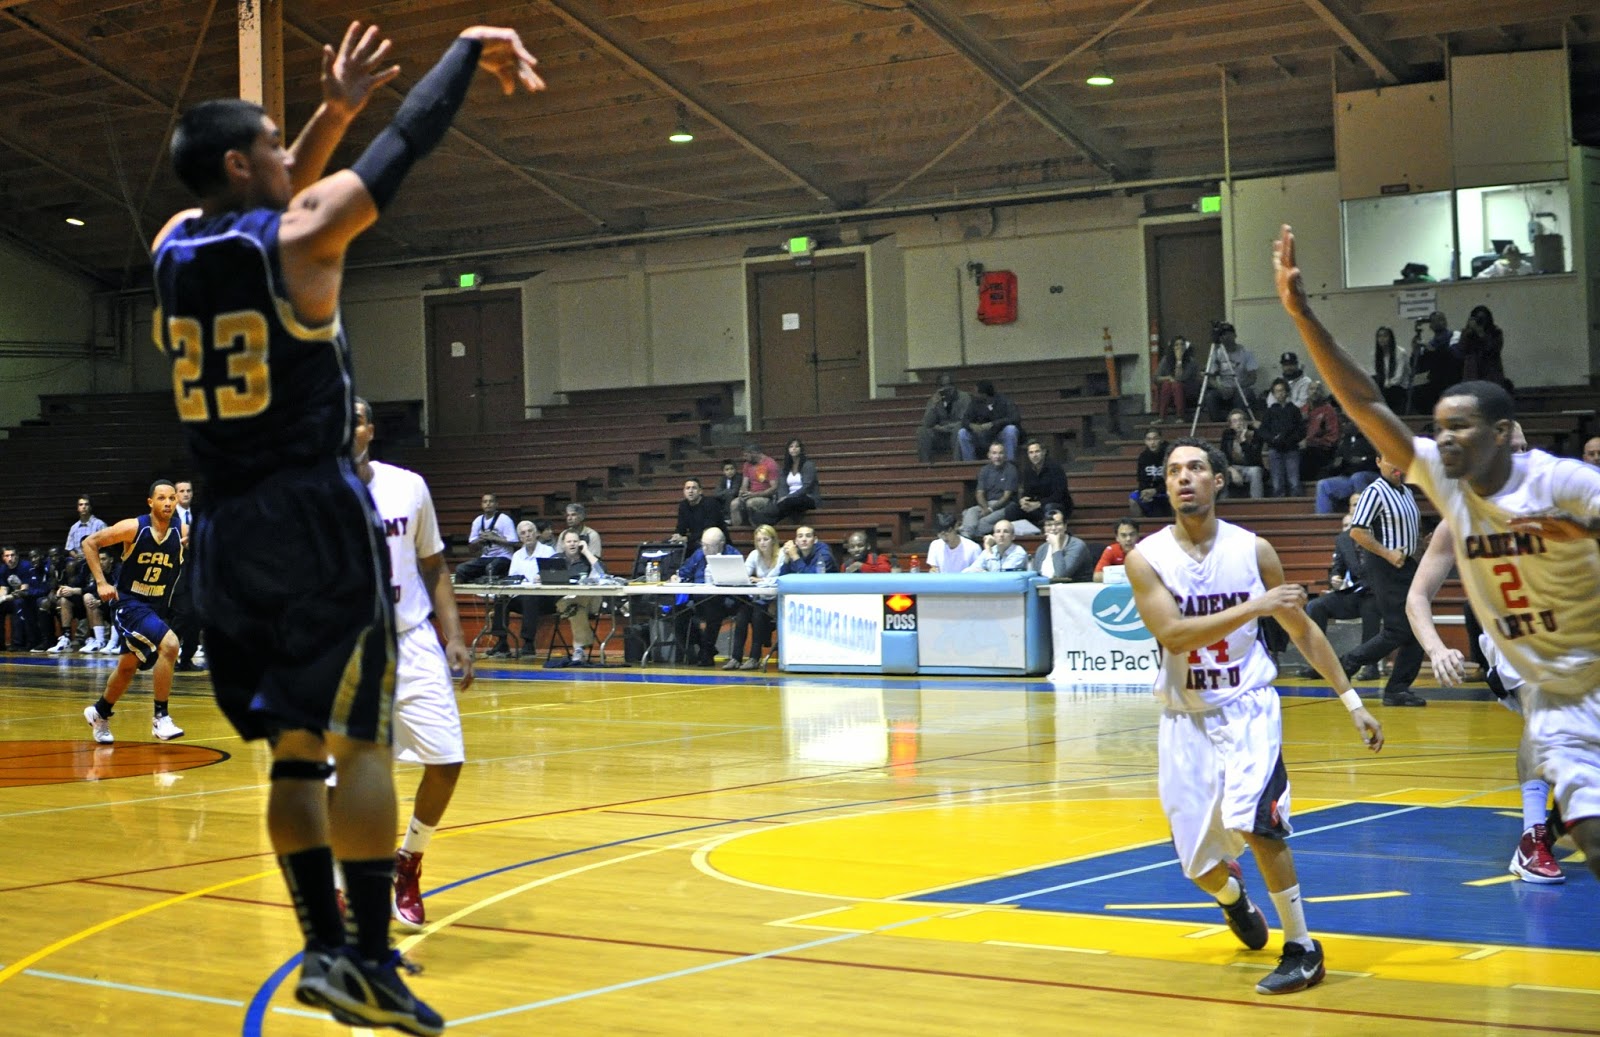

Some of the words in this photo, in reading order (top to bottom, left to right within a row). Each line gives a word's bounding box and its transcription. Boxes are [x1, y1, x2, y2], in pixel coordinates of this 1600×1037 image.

[168, 310, 271, 421] 23
[1466, 532, 1547, 559] CADEMY
[137, 552, 173, 568] CAL
[143, 566, 162, 582] 13
[1493, 563, 1529, 608] 2
[1174, 592, 1250, 617] CADEMY
[886, 614, 915, 630] POSS
[1067, 651, 1106, 671] The
[1110, 650, 1149, 671] Pac
